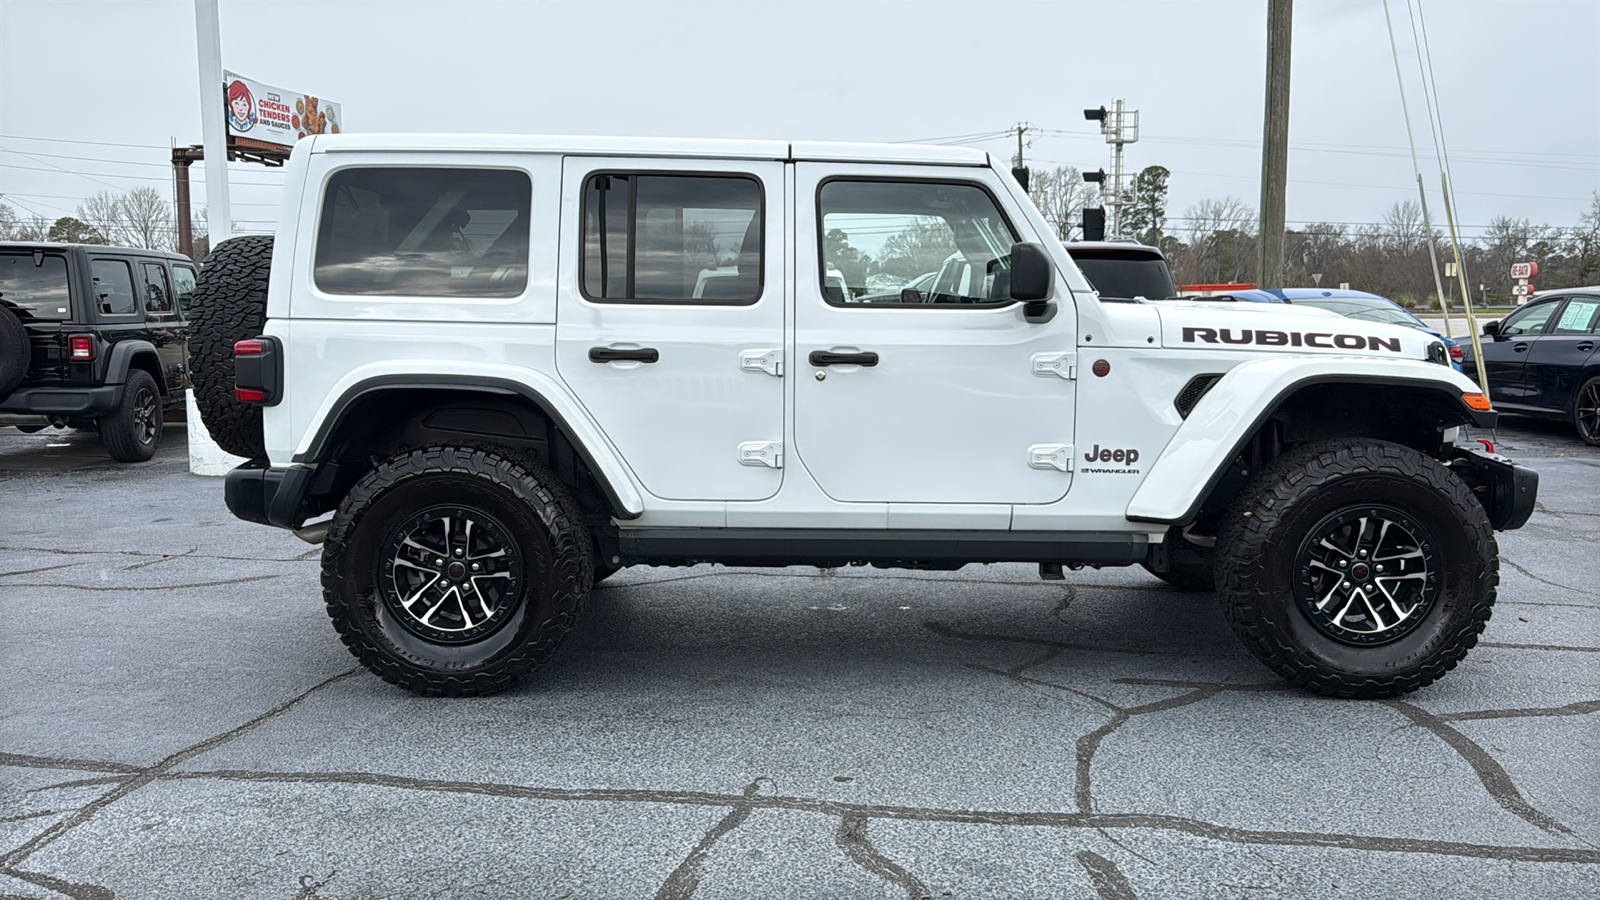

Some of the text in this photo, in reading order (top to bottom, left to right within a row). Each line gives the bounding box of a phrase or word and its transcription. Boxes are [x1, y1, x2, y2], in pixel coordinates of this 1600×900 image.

[258, 99, 290, 113] CHICKEN
[258, 108, 290, 123] TENDERS
[259, 118, 291, 130] AND SAUCES
[1182, 326, 1402, 353] RUBICON
[1084, 444, 1139, 466] Jeep
